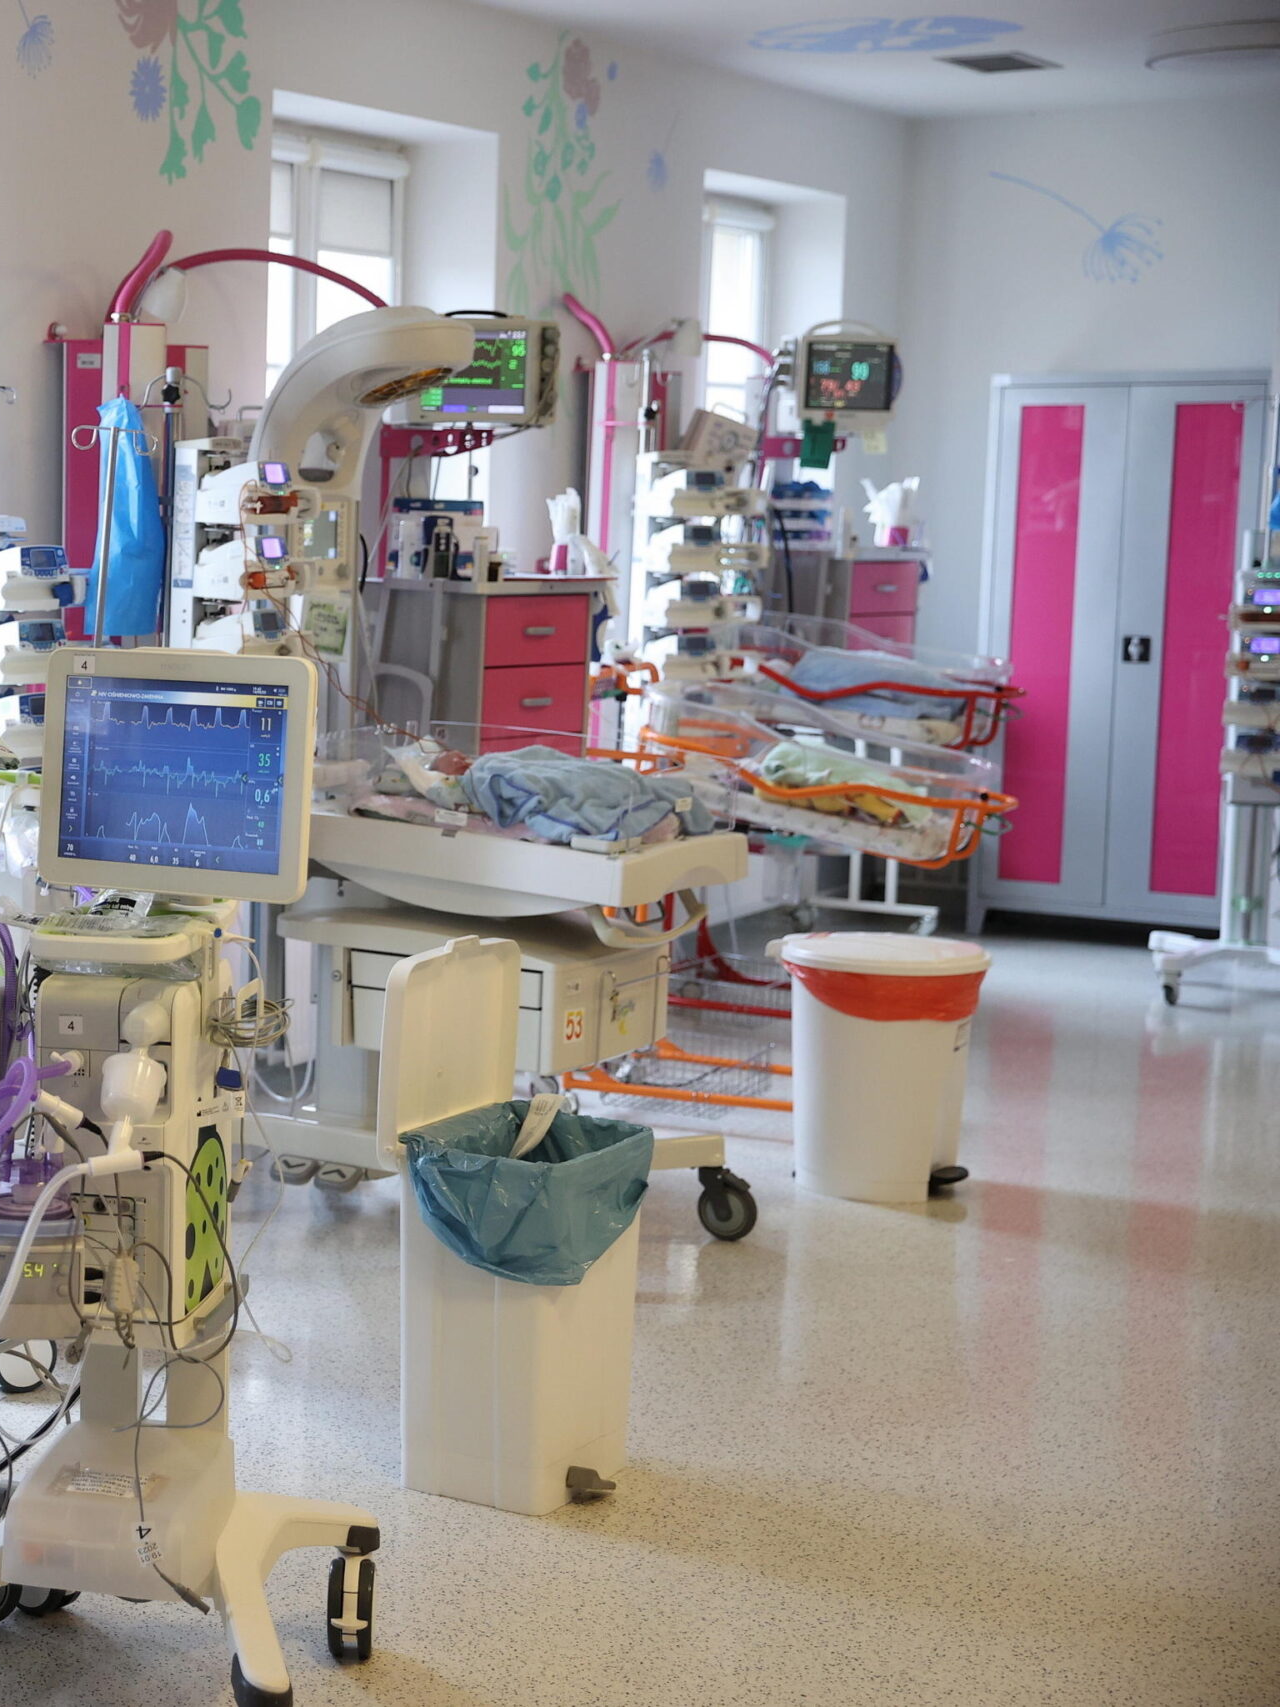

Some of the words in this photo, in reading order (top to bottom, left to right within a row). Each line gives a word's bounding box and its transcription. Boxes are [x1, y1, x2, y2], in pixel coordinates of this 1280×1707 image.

[81, 660, 89, 671] 4
[258, 753, 271, 767] 35
[254, 788, 270, 805] 0,6
[67, 1021, 75, 1031] 4
[565, 1010, 583, 1041] 53
[135, 1525, 152, 1539] 4
